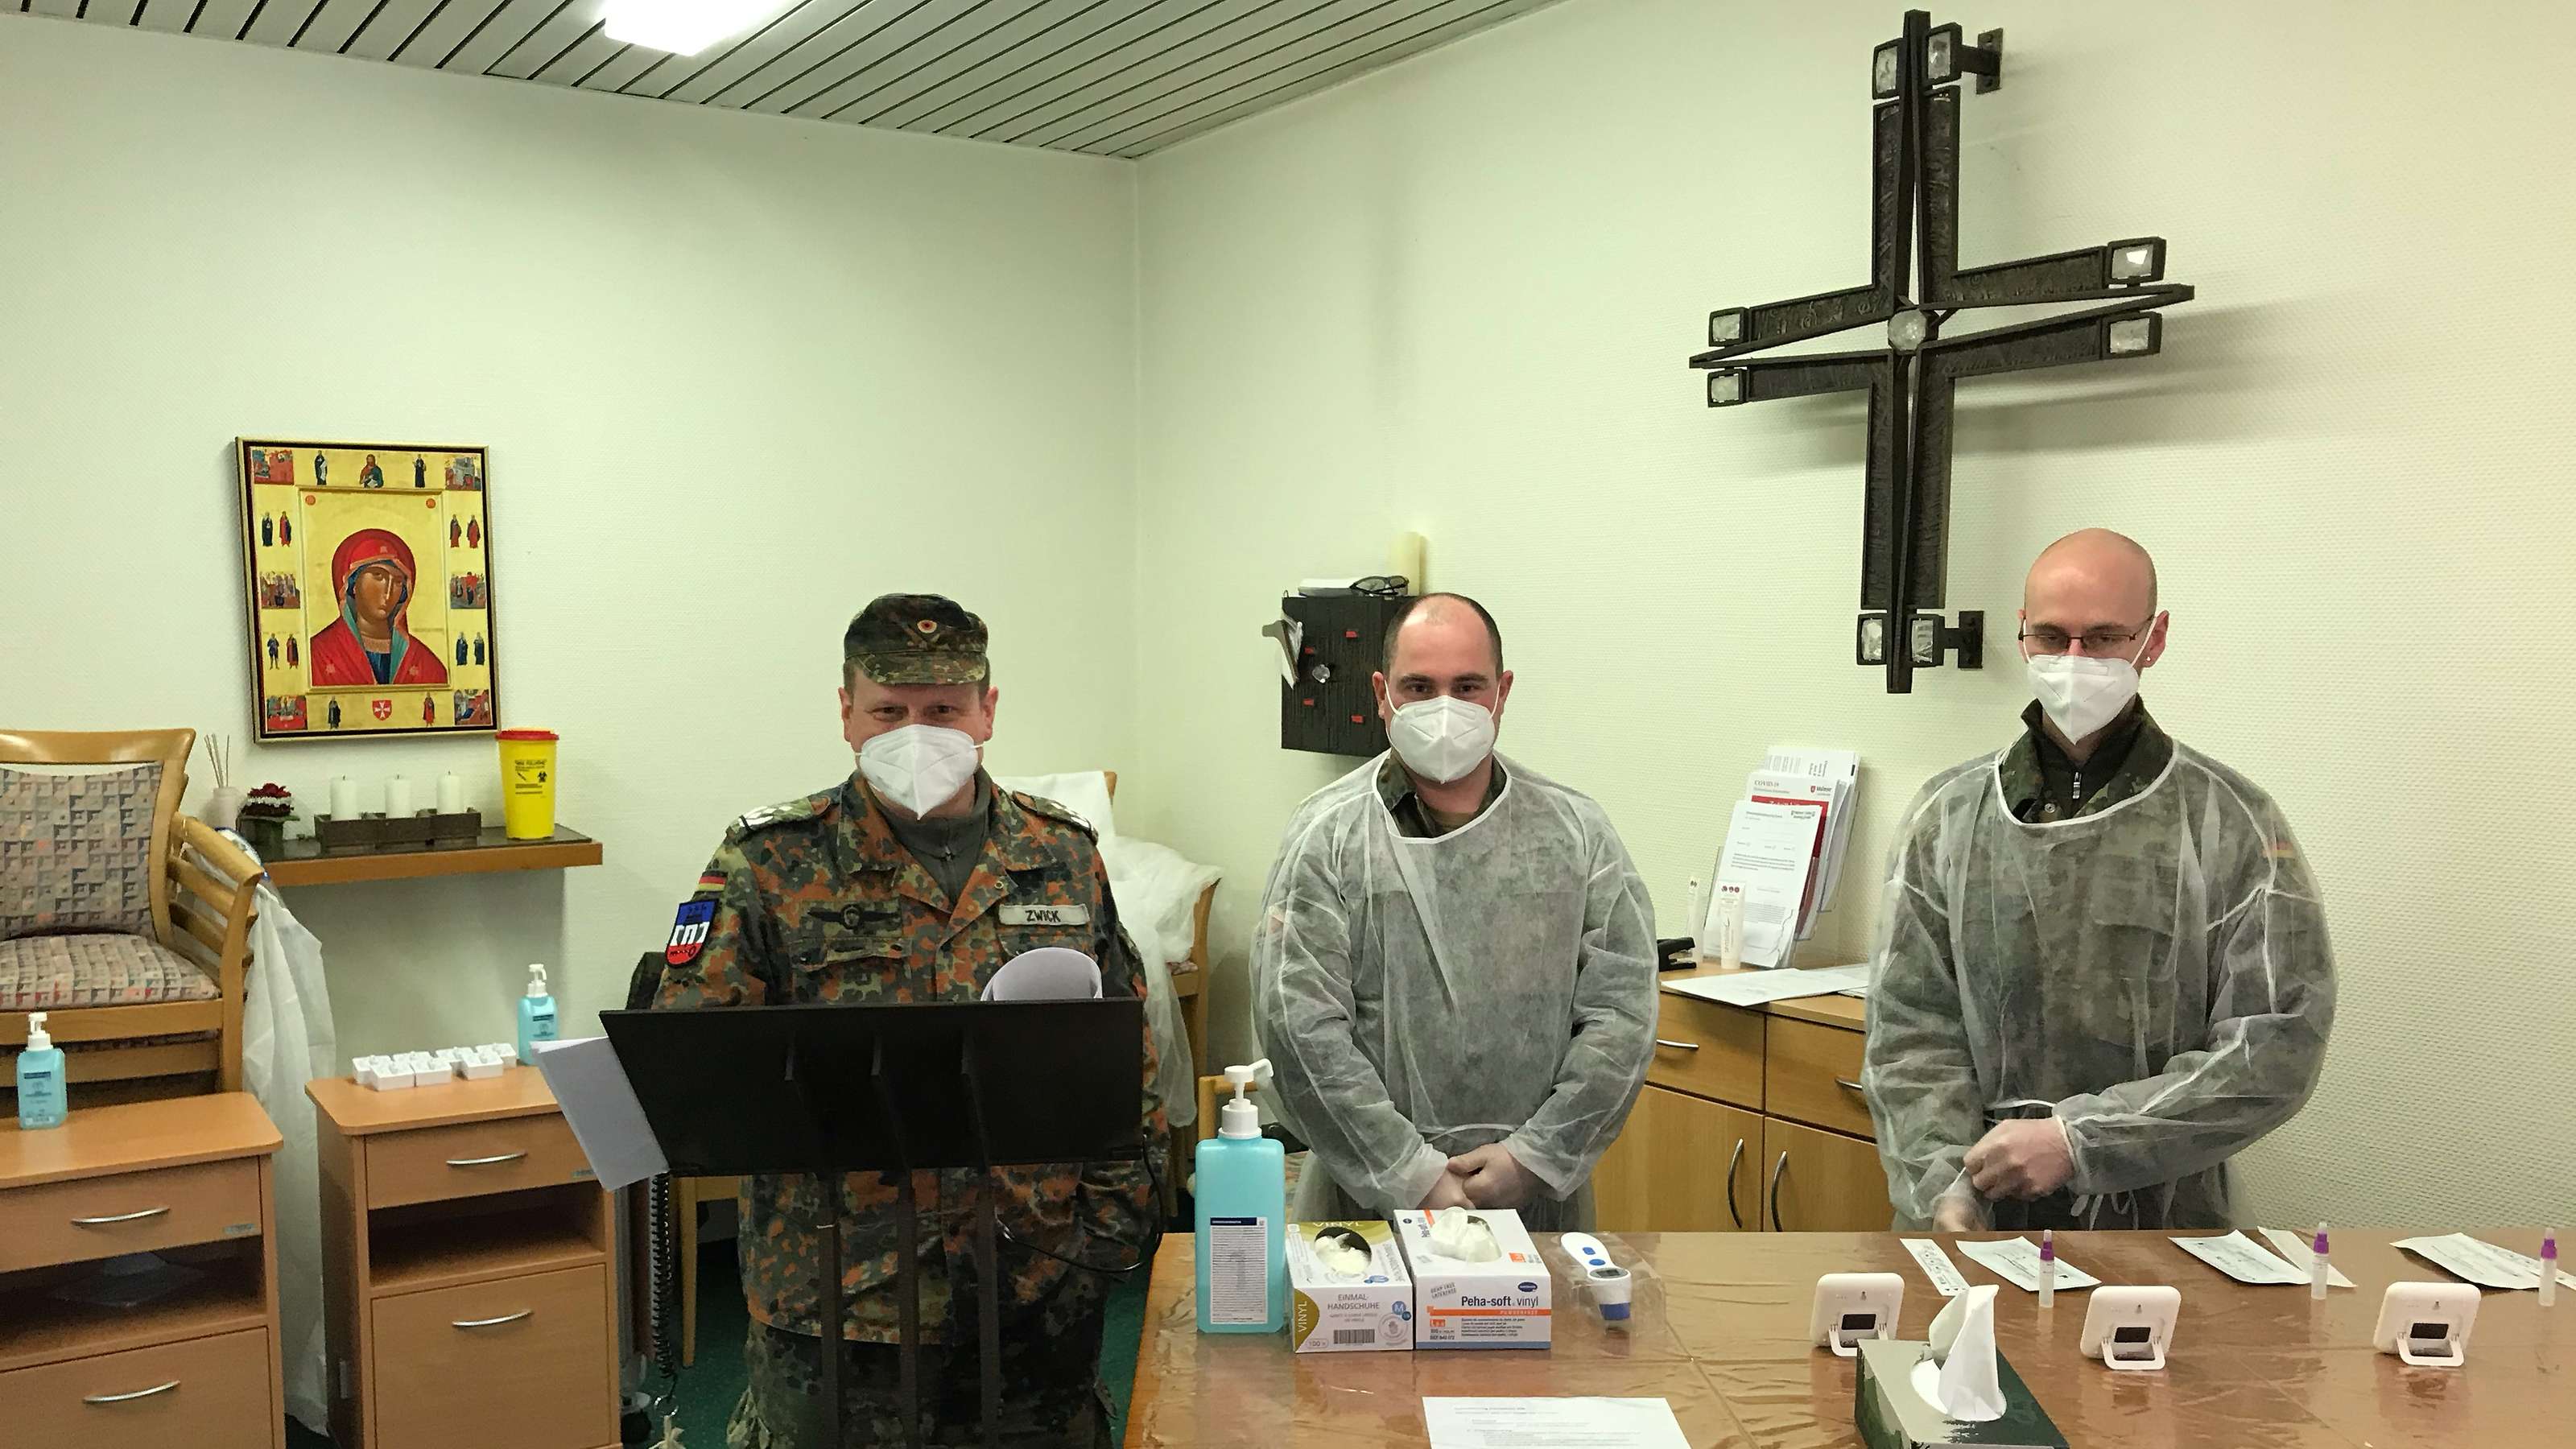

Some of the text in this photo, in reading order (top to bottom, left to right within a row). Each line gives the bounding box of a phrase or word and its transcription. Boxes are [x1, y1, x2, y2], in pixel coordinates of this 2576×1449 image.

[1025, 910, 1061, 923] ZWICK
[1327, 1302, 1380, 1310] HANDSCHUHE
[1394, 1302, 1404, 1312] M
[1461, 1295, 1538, 1308] Peha-soft vinyl
[1298, 1300, 1307, 1332] VINYL
